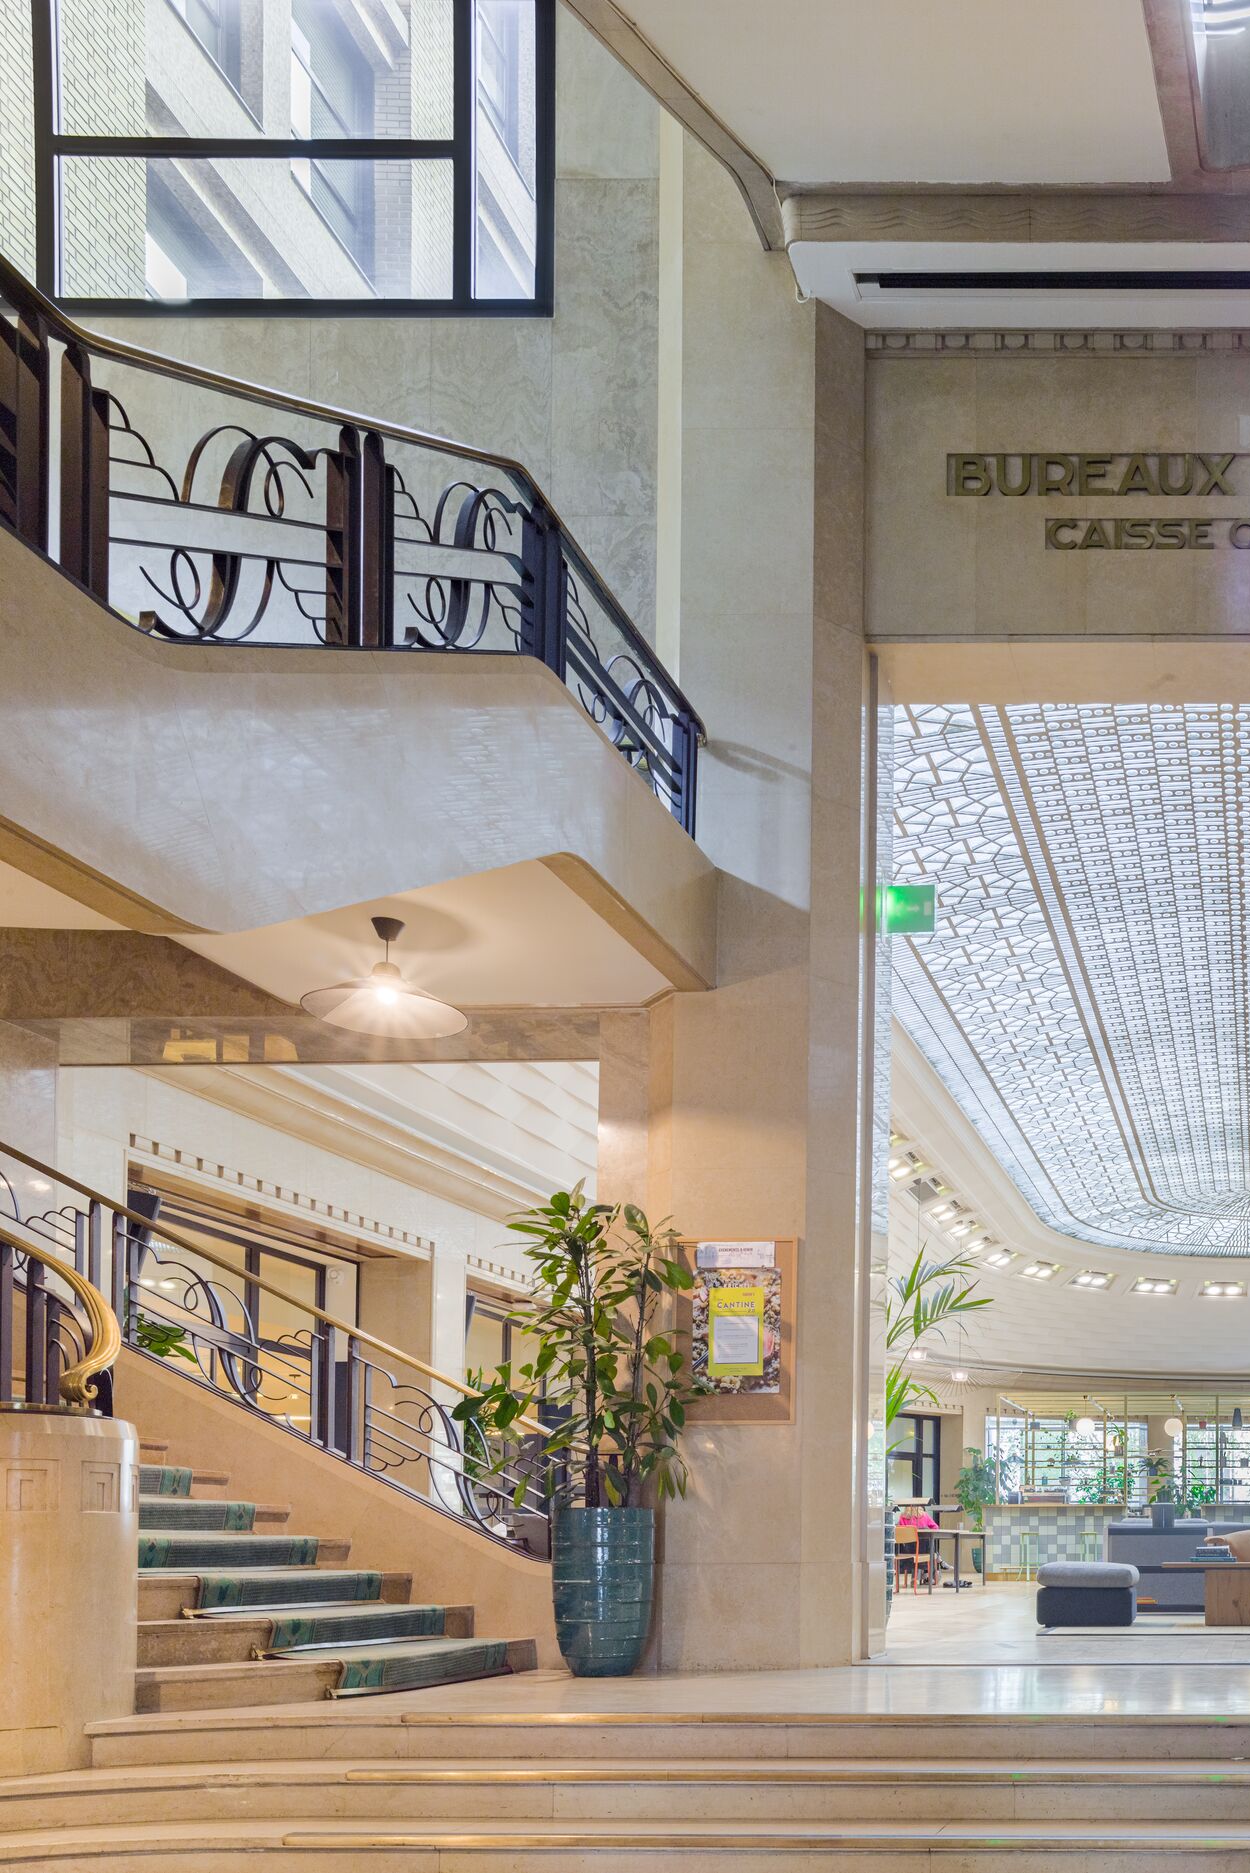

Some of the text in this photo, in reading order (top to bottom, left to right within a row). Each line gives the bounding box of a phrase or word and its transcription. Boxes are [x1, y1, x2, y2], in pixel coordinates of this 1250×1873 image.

[953, 453, 1236, 496] BUREAUX
[1047, 518, 1211, 550] CAISSE
[717, 1301, 755, 1309] CANTINE
